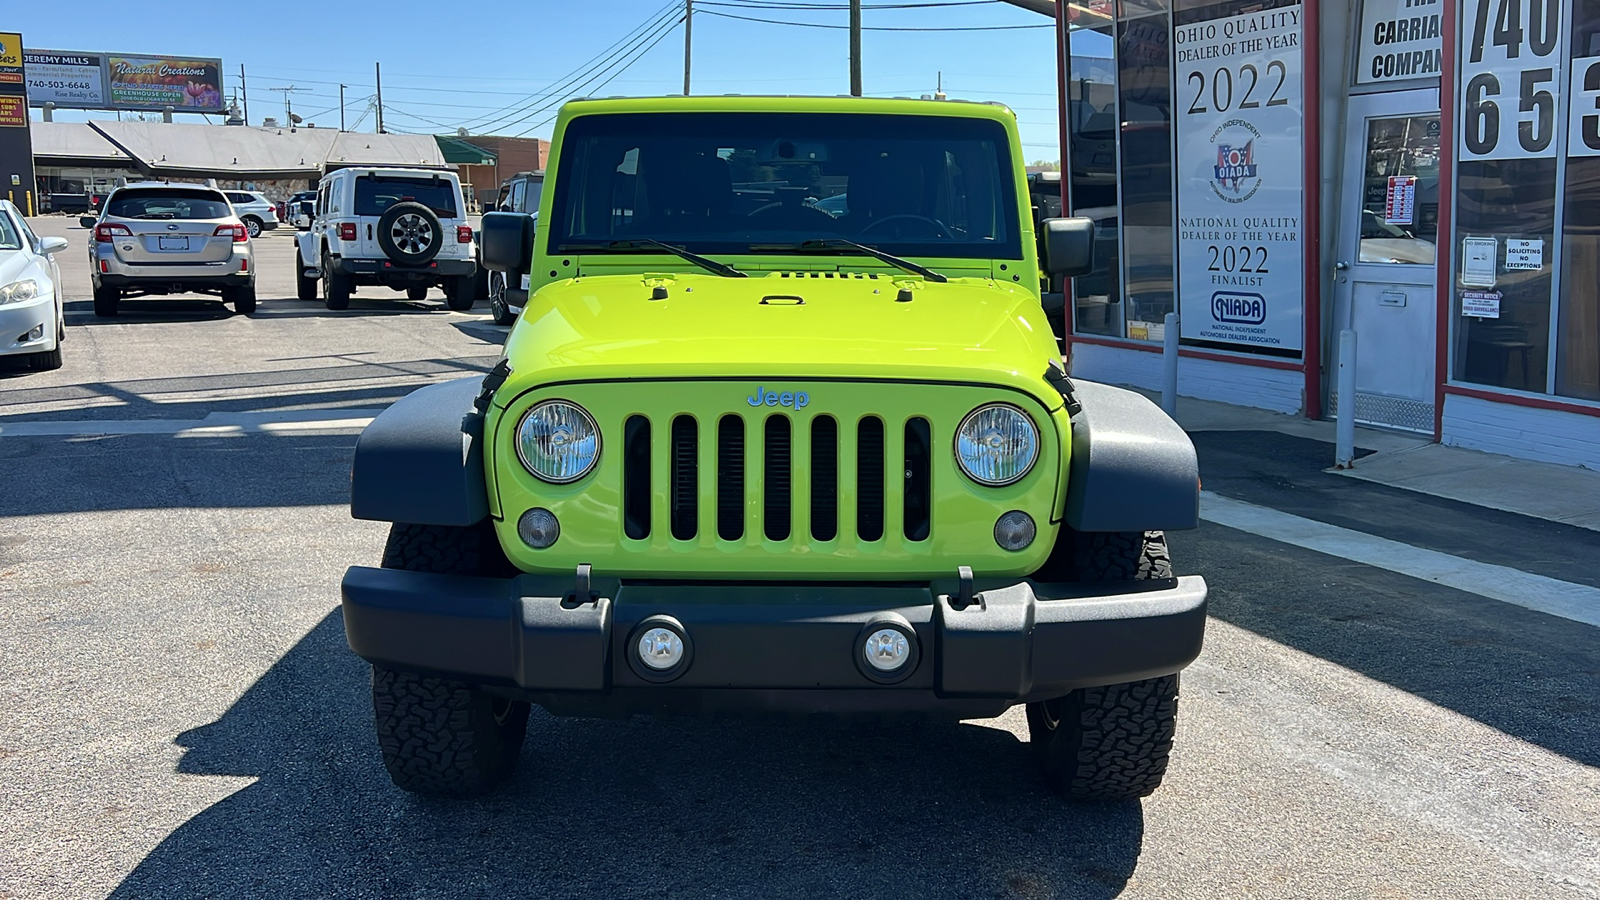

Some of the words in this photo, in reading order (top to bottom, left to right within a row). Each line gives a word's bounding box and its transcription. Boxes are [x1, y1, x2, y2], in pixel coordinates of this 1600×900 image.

[1177, 25, 1216, 44] OHIO
[1224, 10, 1300, 39] QUALITY
[1374, 15, 1442, 46] CARRIA
[1179, 45, 1220, 63] DEALER
[1222, 43, 1237, 56] OF
[1240, 38, 1263, 54] THE
[1266, 32, 1298, 50] YEAR
[24, 55, 60, 64] JEREMY
[62, 57, 89, 65] MILLS
[115, 63, 157, 75] Natural
[159, 64, 205, 76] Creations
[28, 80, 91, 90] 740-503-6648
[1187, 60, 1288, 115] 2022
[1210, 127, 1223, 143] OHIO
[1222, 119, 1262, 139] INDEPENDENT
[1219, 166, 1250, 178] OIADA
[1181, 218, 1238, 228] NATIONAL
[1243, 218, 1298, 229] QUALITY
[1182, 231, 1220, 240] DEALER
[1224, 231, 1237, 240] OF
[1242, 232, 1262, 240] THE
[1268, 232, 1297, 241] YEAR
[1208, 245, 1269, 273] 2022
[1211, 275, 1263, 286] FINALIST
[1216, 298, 1261, 318] NIADA
[1235, 326, 1266, 334] INDEPENDENT
[1200, 331, 1227, 339] AUTOMOBILE
[1228, 333, 1247, 341] DEALERS
[1248, 336, 1280, 344] ASSOCIATION
[747, 386, 810, 411] Jeep
